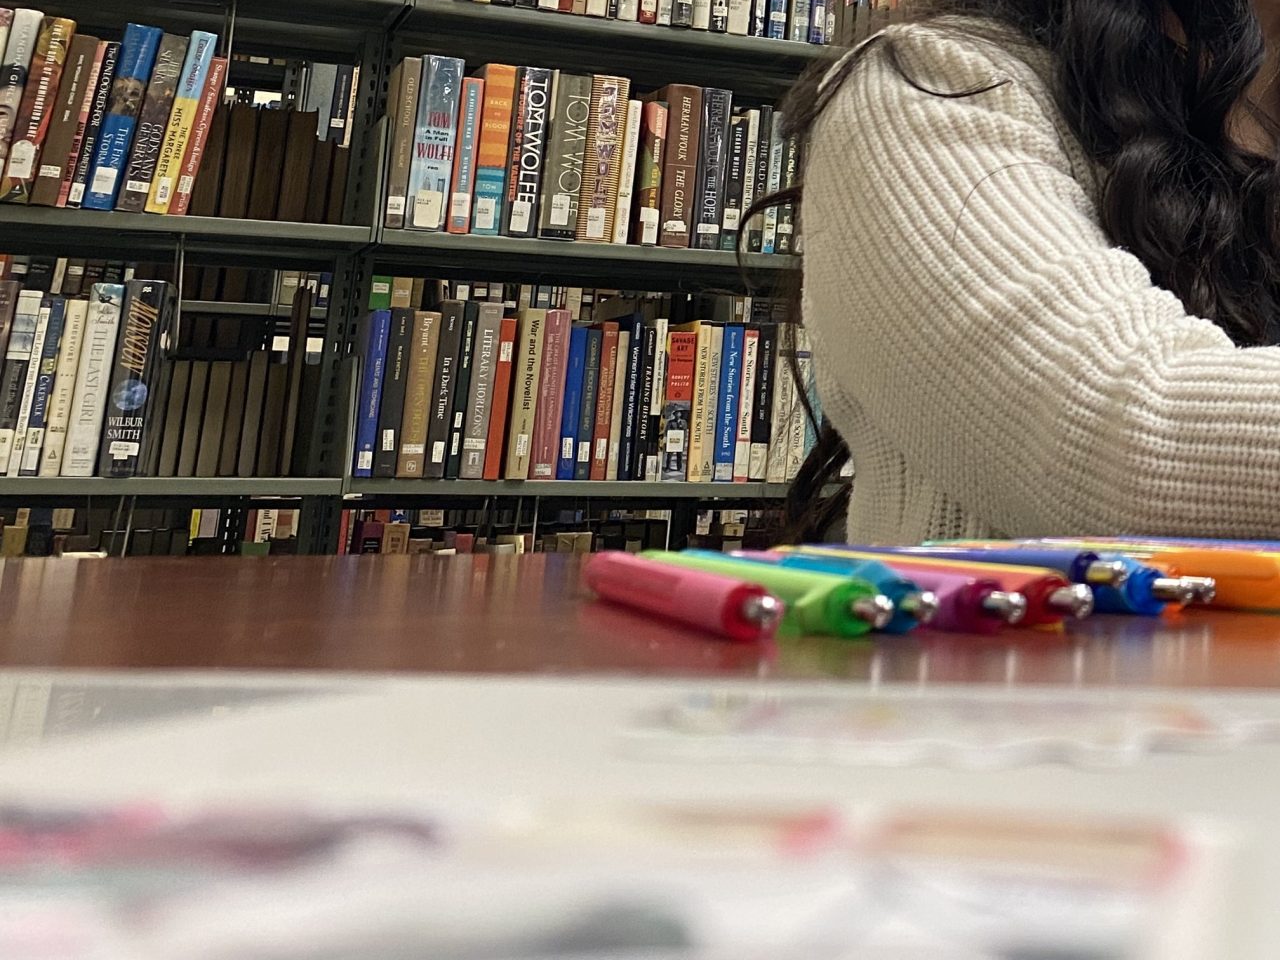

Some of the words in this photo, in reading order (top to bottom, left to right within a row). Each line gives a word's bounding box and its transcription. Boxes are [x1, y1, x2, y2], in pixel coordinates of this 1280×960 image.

[108, 47, 116, 58] The
[90, 59, 115, 127] UNLOOKED-FOR
[407, 77, 415, 95] OLD
[403, 95, 412, 128] SCHOOL
[527, 78, 548, 124] TOM
[172, 108, 183, 127] MISS
[428, 111, 450, 128] TOM
[679, 96, 691, 133] HERMAN
[711, 94, 725, 138] HERMAN
[146, 124, 163, 153] GODS
[178, 127, 188, 140] THE
[733, 127, 743, 154] RICHARD
[79, 137, 95, 175] ELIZABETH
[129, 122, 152, 177] GENERALS
[158, 130, 179, 177] MARGARETS
[173, 140, 185, 160] THREE
[417, 142, 453, 161] WOLFE
[677, 134, 688, 161] WOUK
[706, 140, 720, 172] WOUK
[140, 154, 157, 179] AND
[517, 130, 542, 204] WOLFE
[675, 169, 685, 188] THE
[731, 157, 740, 181] WRIGHT
[707, 176, 716, 189] THE
[672, 190, 684, 219] GLORY
[703, 190, 716, 218] HOPE
[120, 296, 159, 376] MONSOON
[419, 317, 433, 347] Bryant
[530, 319, 540, 337] War
[93, 329, 108, 357] THE
[478, 329, 493, 380] LITERARY
[528, 338, 537, 356] and
[700, 346, 708, 360] NEW
[747, 340, 755, 358] New
[527, 357, 536, 372] the
[631, 347, 640, 373] Women
[729, 351, 738, 366] New
[85, 361, 103, 391] LAST
[630, 374, 638, 392] Enter
[697, 361, 707, 386] STORIES
[726, 367, 736, 393] Stories
[744, 359, 753, 387] Stories
[522, 373, 534, 411] Novelist
[629, 392, 637, 402] the
[696, 386, 704, 407] FROM
[725, 394, 734, 411] from
[78, 393, 98, 426] GIRL
[471, 382, 489, 436] HORIZONS
[625, 403, 636, 437] Wilderness
[724, 412, 732, 426] the
[107, 429, 140, 440] SMITH
[108, 417, 143, 427] WILBUR
[694, 423, 702, 443] SOUTH
[740, 411, 749, 436] South
[722, 426, 731, 448] South
